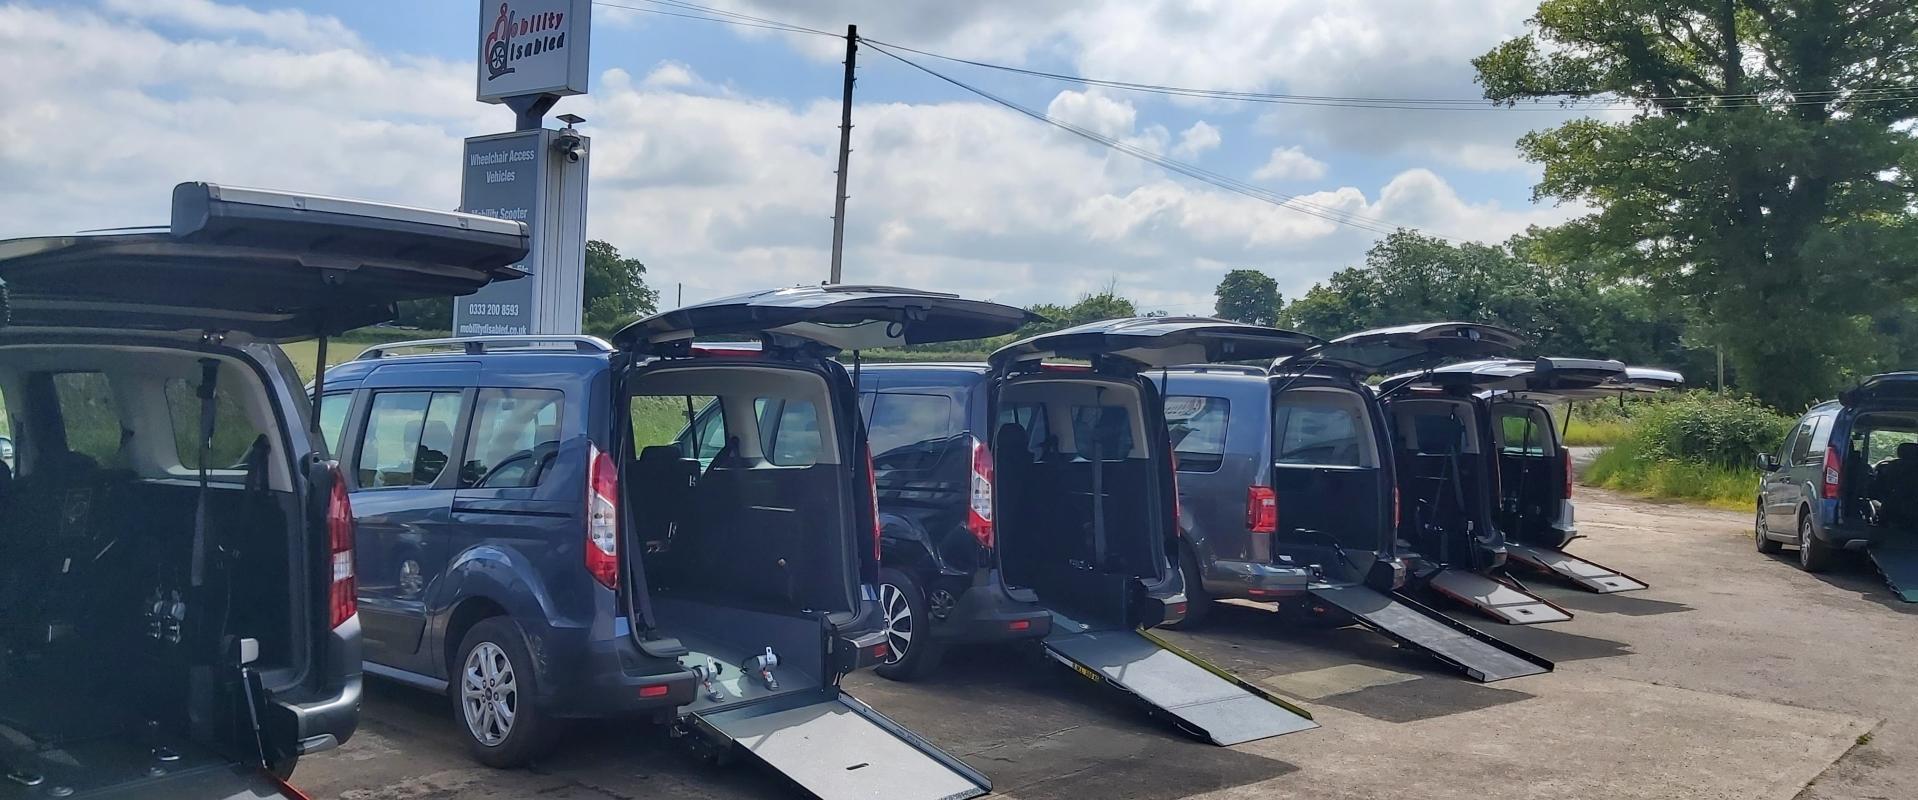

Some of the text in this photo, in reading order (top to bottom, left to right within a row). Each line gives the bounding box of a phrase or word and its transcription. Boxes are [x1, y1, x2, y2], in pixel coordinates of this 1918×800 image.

[470, 149, 535, 167] Wheelchair Access
[486, 169, 515, 184] Vehicles
[500, 207, 528, 220] Scooter
[469, 303, 519, 316] 0333 200 8593
[460, 323, 527, 335] mobilitydisabled.co.uk
